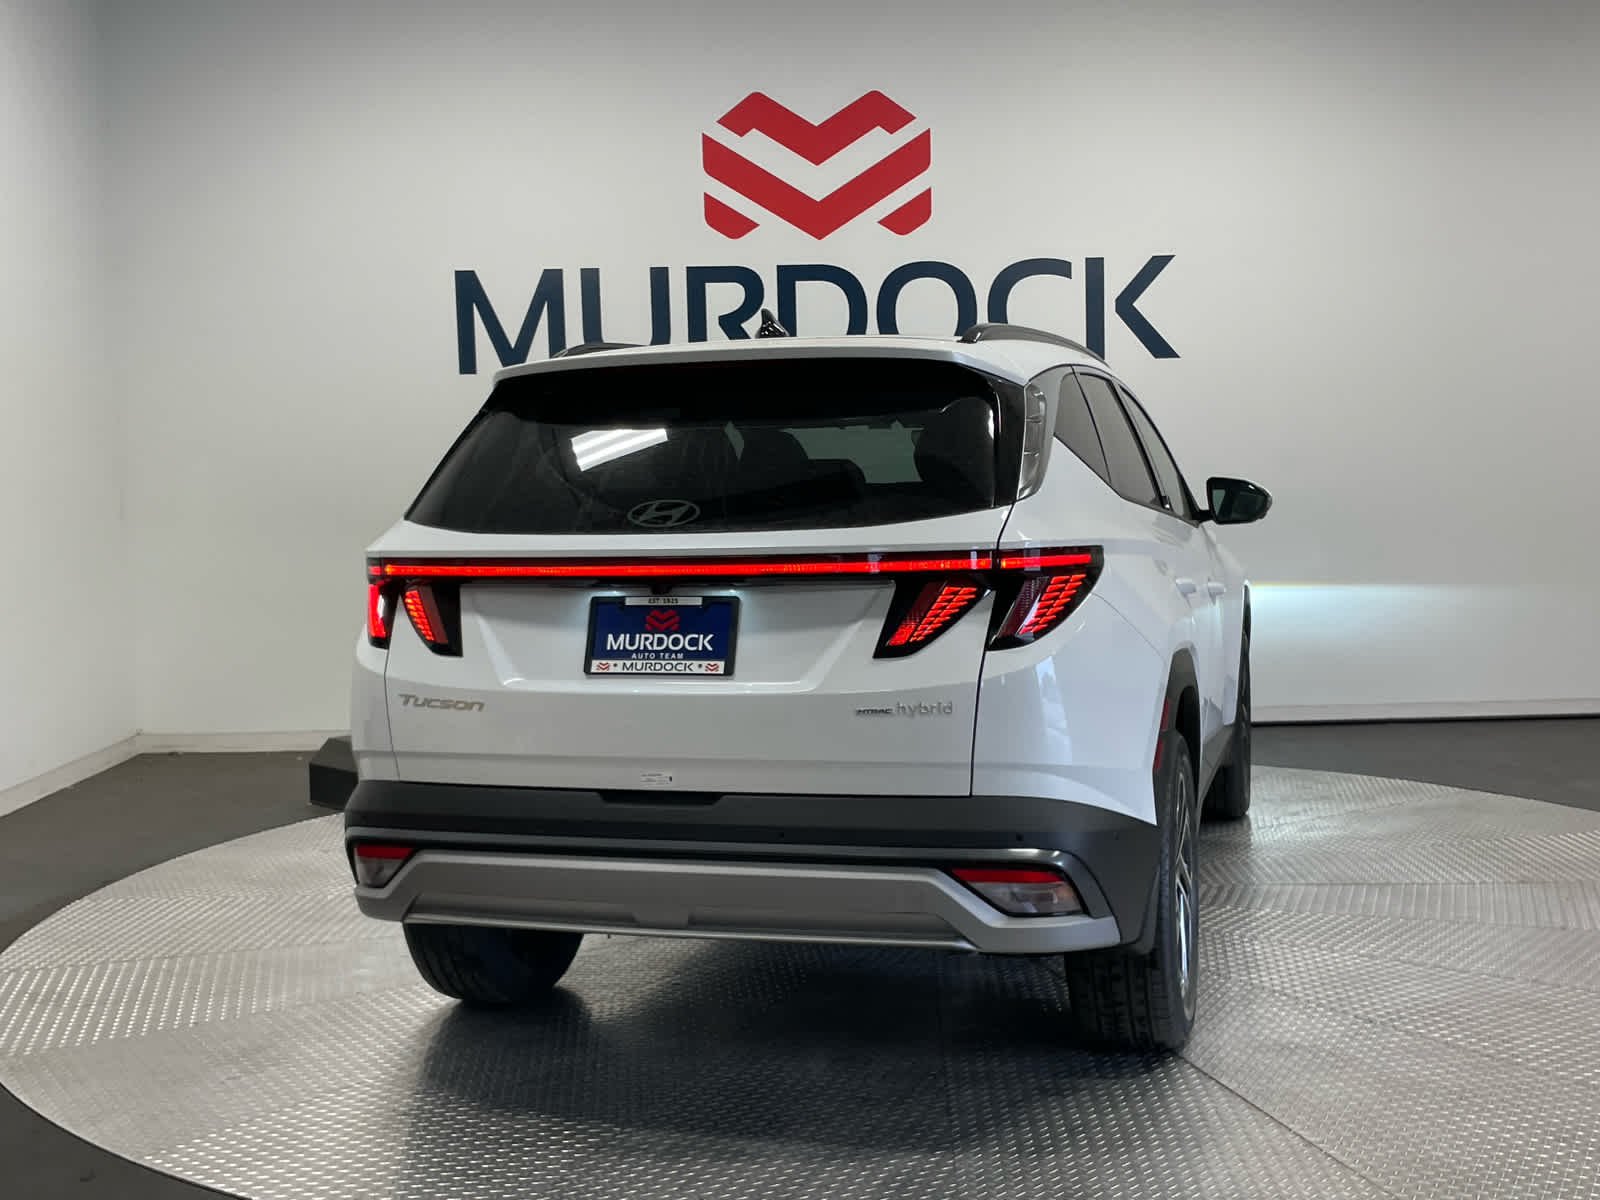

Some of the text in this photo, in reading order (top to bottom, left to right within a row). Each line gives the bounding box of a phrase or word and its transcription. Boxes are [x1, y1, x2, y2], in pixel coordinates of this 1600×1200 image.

[454, 254, 1180, 375] MURDOCK
[606, 633, 714, 651] MURDOCK
[631, 652, 684, 660] AUTO TEAM
[622, 662, 694, 672] MURDOCK
[896, 701, 952, 717] hybrid
